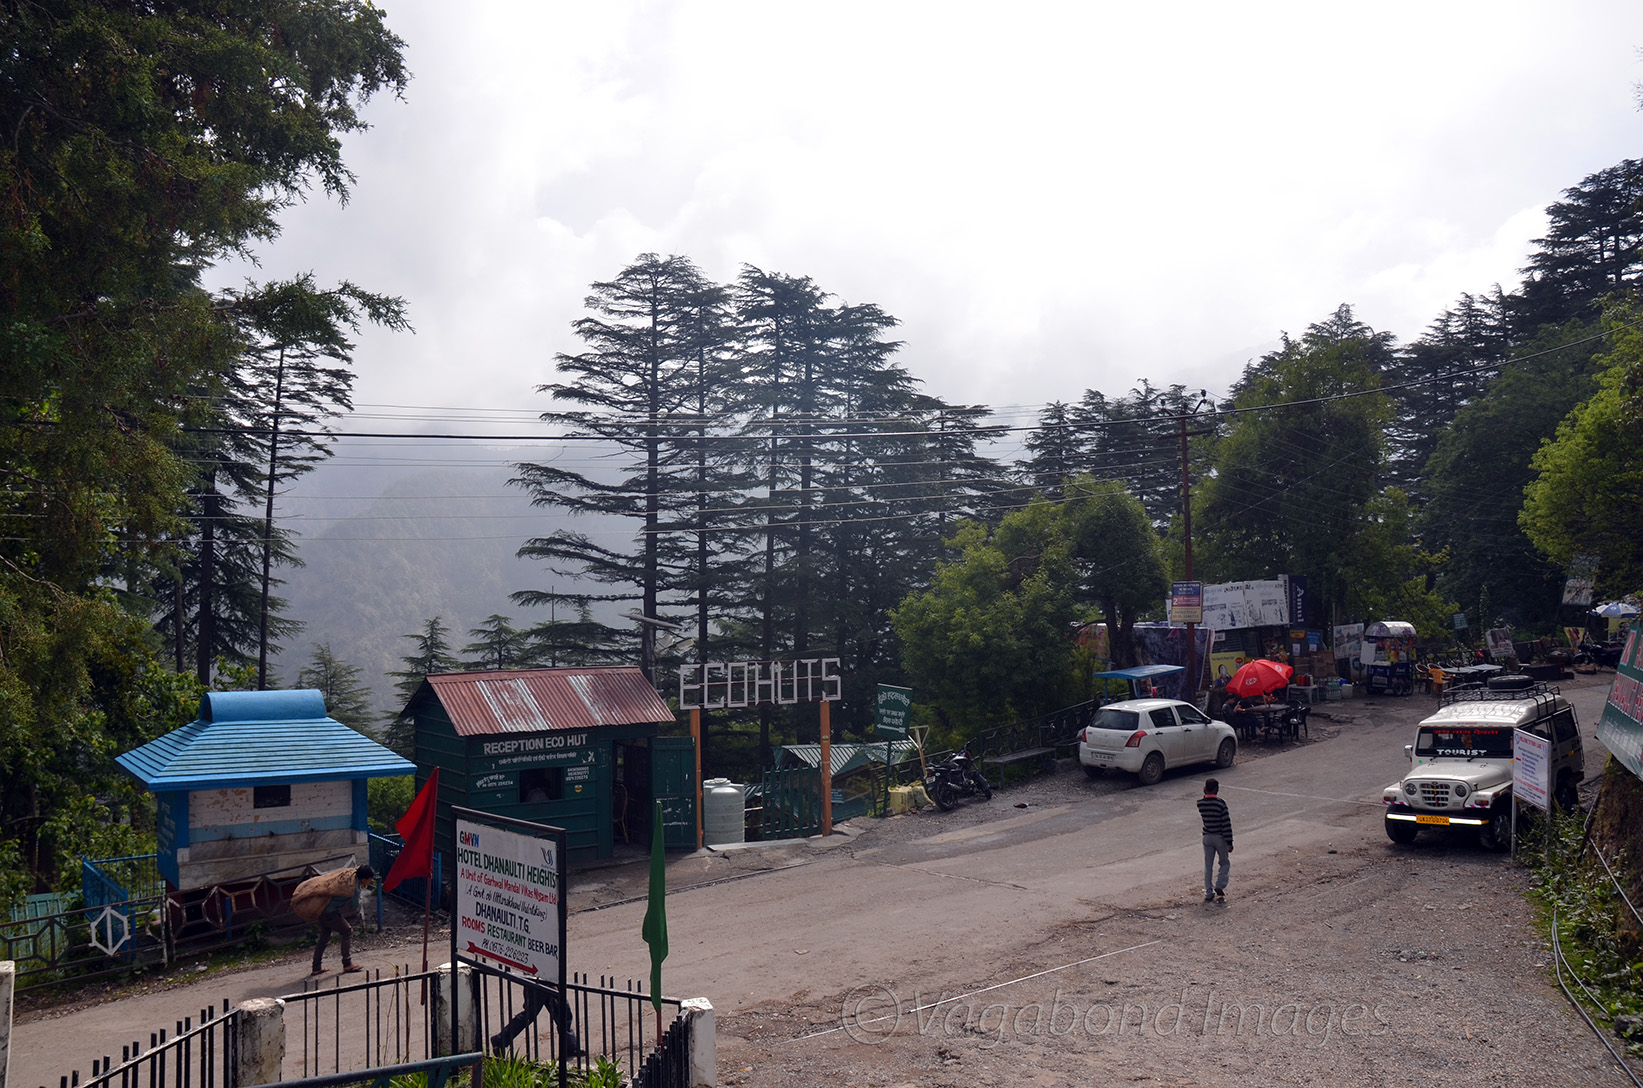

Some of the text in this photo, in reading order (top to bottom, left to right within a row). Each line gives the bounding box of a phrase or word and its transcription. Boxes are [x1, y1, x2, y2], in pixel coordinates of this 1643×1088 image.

[1296, 585, 1305, 623] Amul
[483, 733, 588, 755] RECEPTION ECO HUT
[460, 830, 479, 848] GMVN
[457, 847, 557, 889] HOTEL DHANAULTI HEIGHTS
[460, 868, 465, 878] A
[465, 868, 476, 880] Unit
[476, 872, 484, 883] of
[484, 873, 503, 890] Garhwal
[503, 879, 520, 895] Mandal
[520, 883, 534, 899] Vikas
[461, 915, 558, 960] ROOMS RESTAURANT BEER BAR
